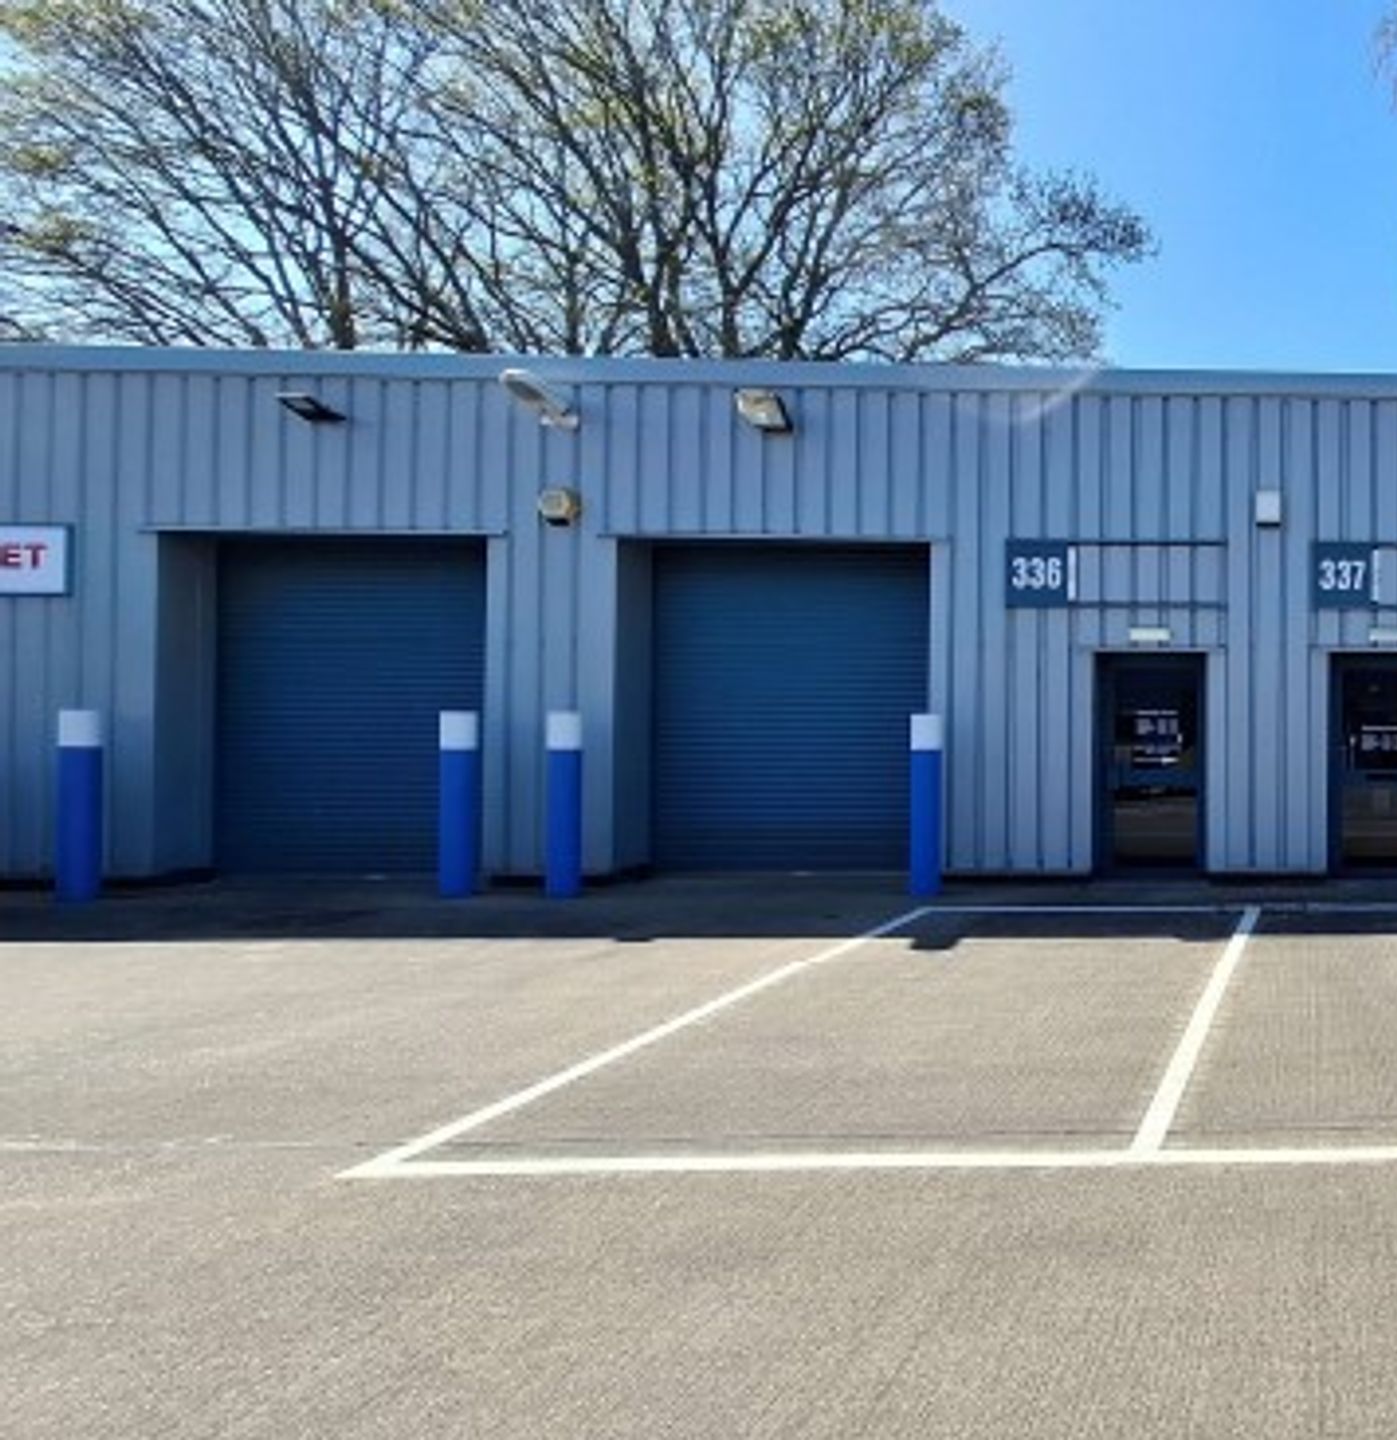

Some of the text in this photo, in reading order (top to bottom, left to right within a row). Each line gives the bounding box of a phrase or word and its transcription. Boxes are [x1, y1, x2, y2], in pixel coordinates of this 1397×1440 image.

[0, 543, 49, 569] ET
[1012, 556, 1062, 590] 336
[1318, 559, 1366, 590] 337
